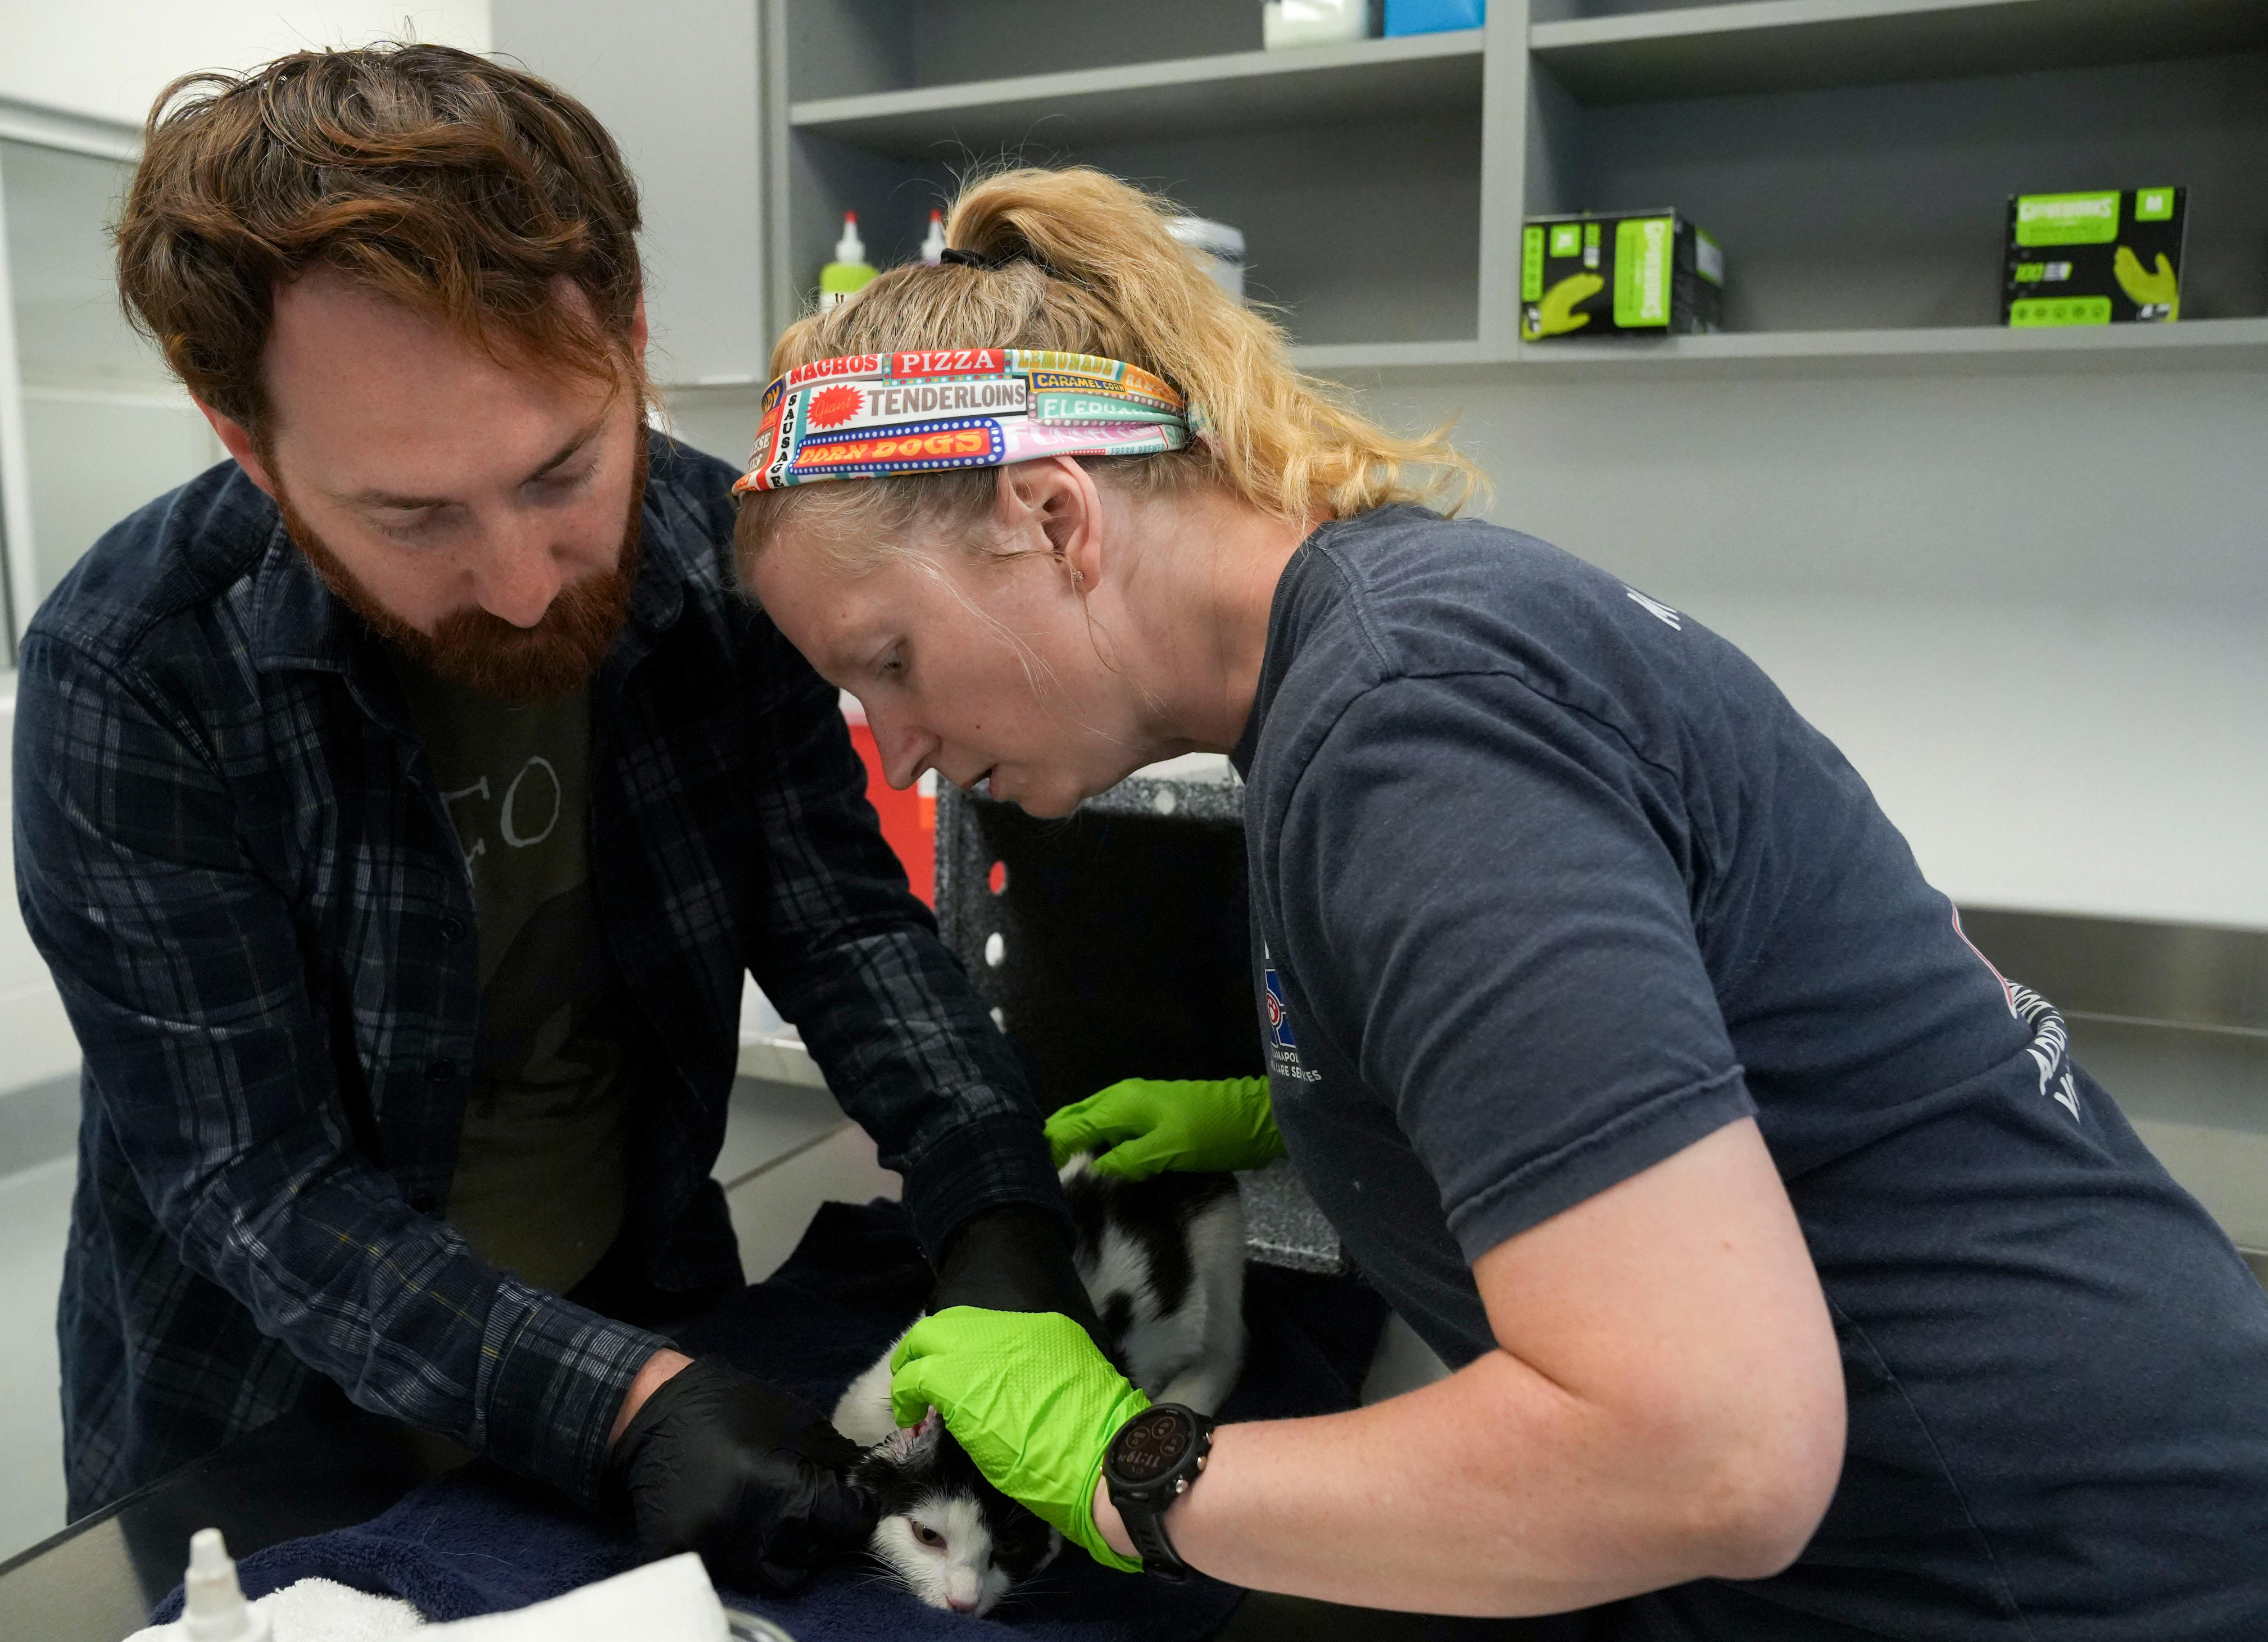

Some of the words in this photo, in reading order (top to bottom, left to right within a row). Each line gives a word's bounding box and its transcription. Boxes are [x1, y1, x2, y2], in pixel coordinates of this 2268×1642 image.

[790, 355, 878, 385] NACHOS
[901, 350, 995, 373] PIZZA
[1018, 350, 1113, 375] LEMONADE
[1037, 374, 1102, 389] CARAMEL
[1103, 382, 1126, 392] CORN
[815, 394, 852, 419] Giant
[867, 384, 1025, 416] TENDERLOINS
[770, 394, 798, 488] SAUSAGE
[798, 444, 869, 465] CORN
[872, 431, 982, 458] DOGS
[1006, 427, 1118, 451] FUNNEL
